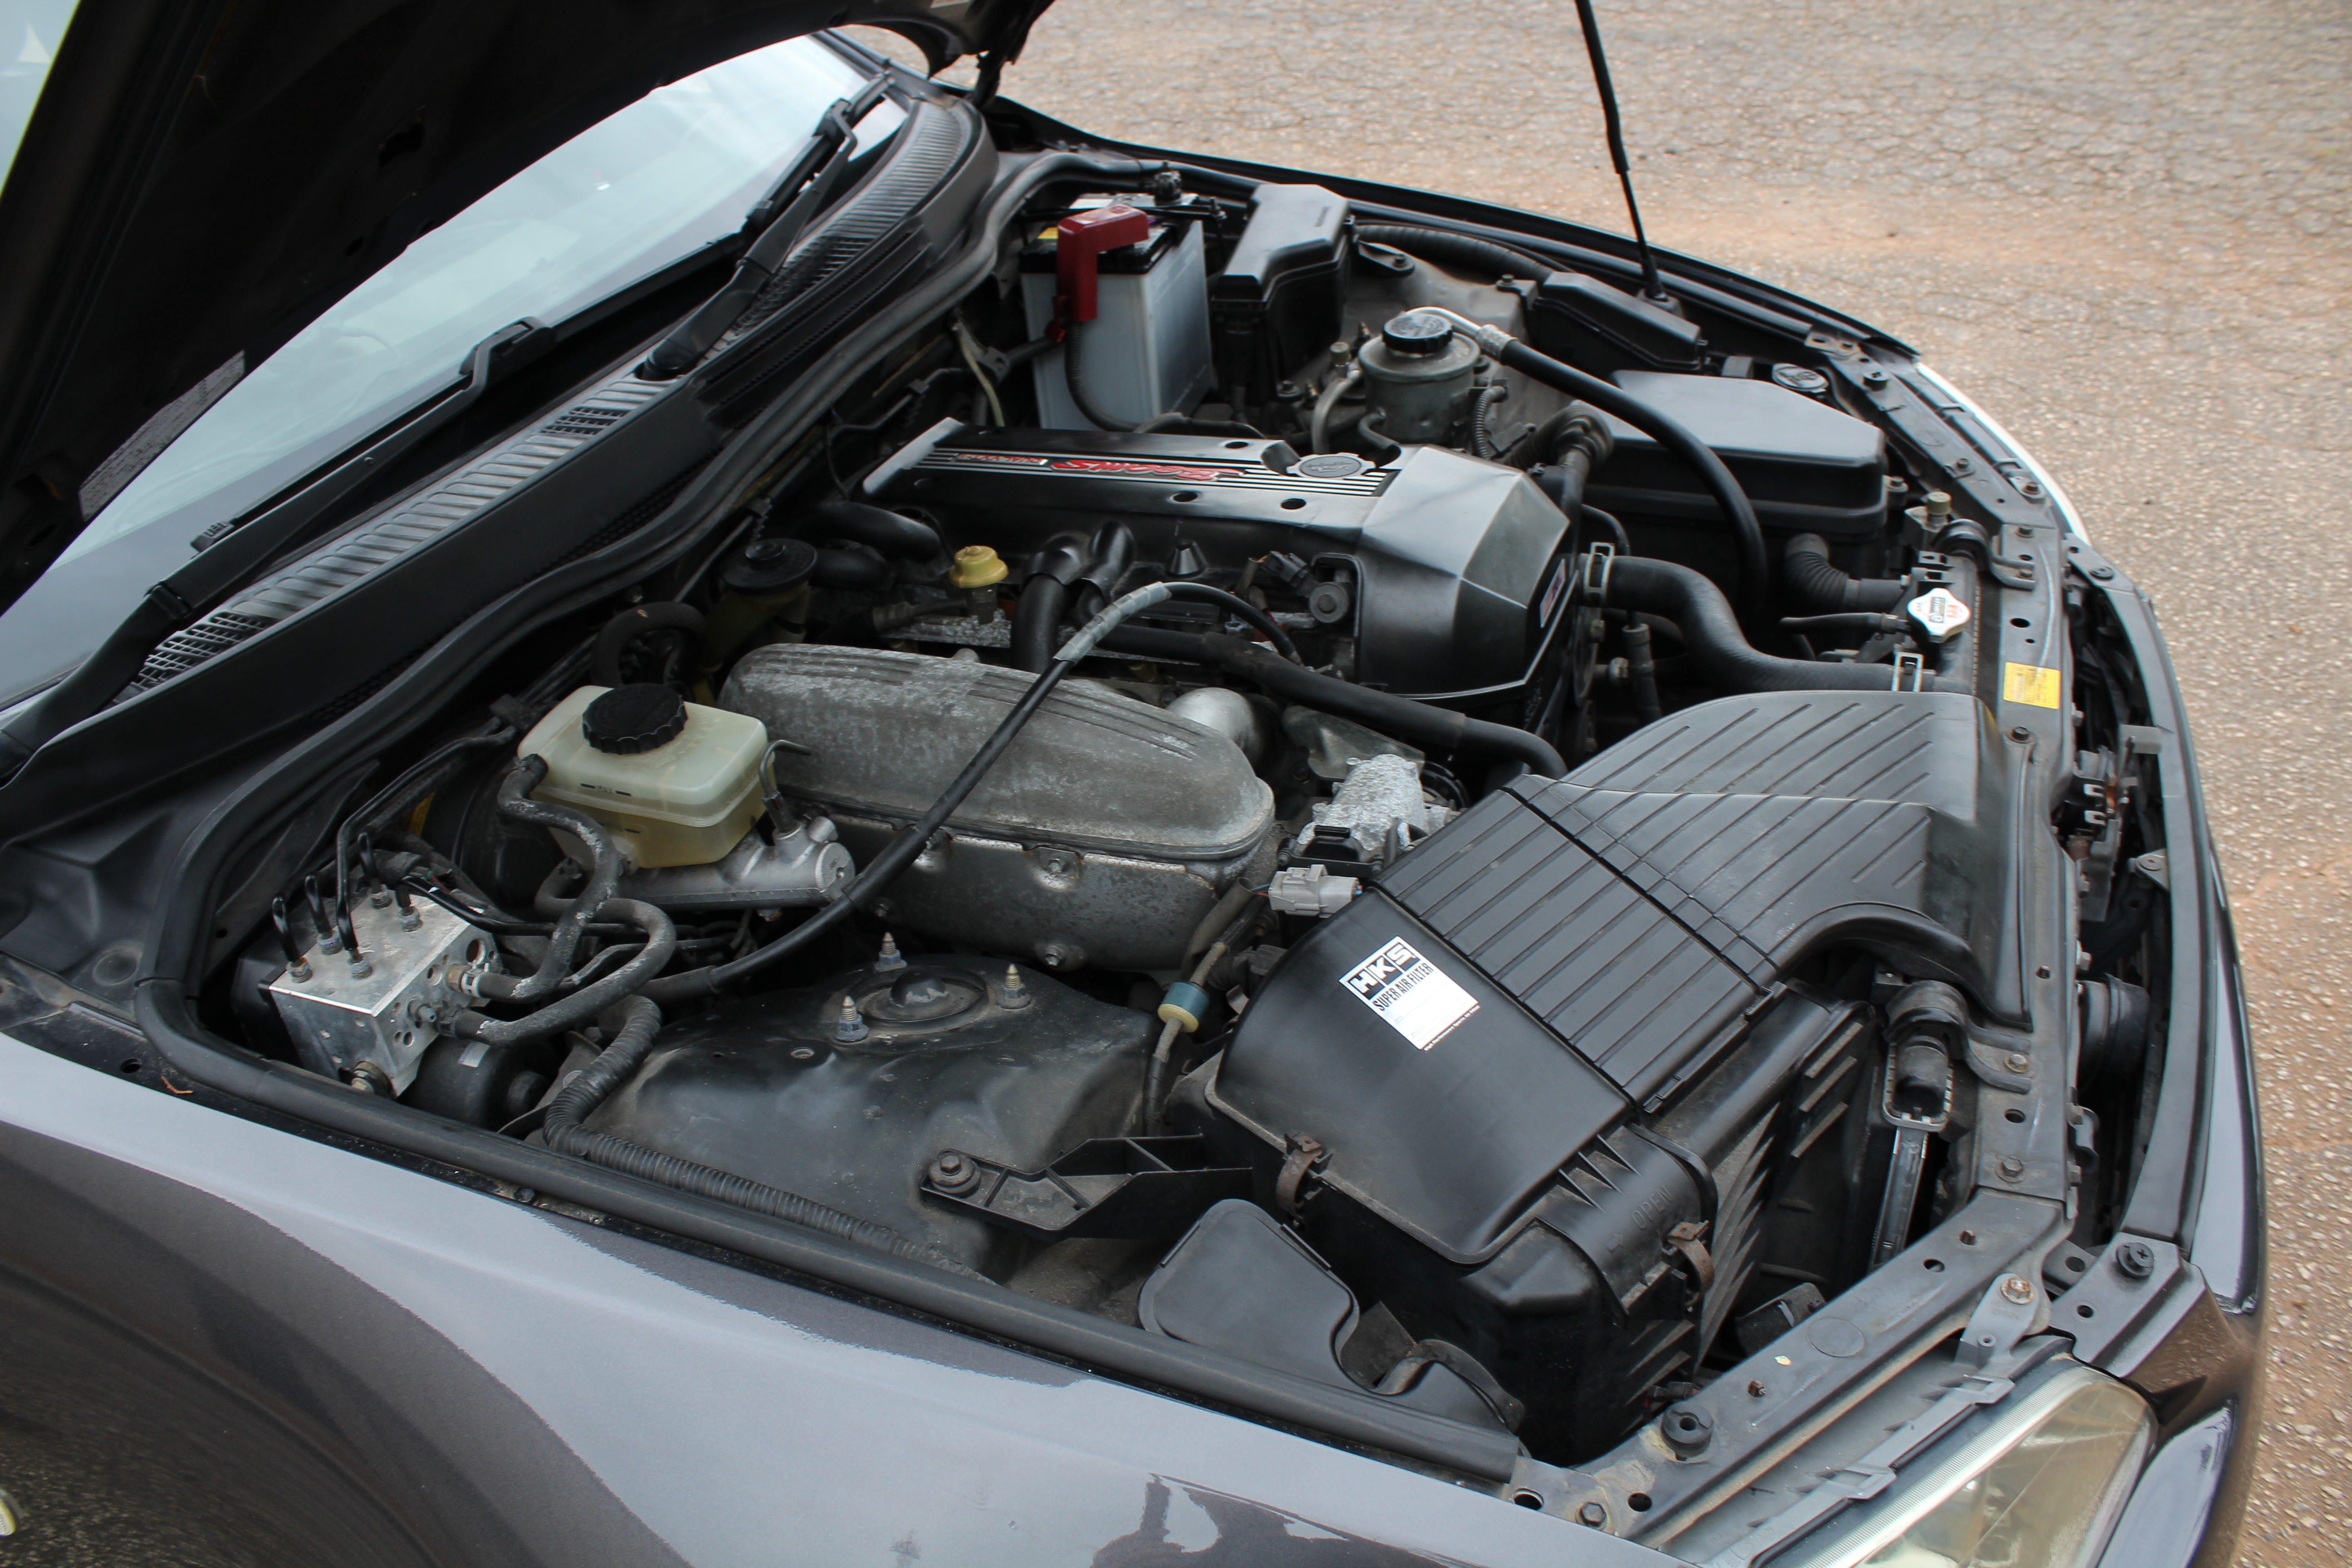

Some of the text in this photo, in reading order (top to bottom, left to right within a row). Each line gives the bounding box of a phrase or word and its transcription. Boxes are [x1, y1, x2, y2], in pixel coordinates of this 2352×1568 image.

[1004, 455, 1043, 463] DUAL
[1349, 944, 1414, 995] HKS
[1372, 962, 1434, 1011] SUPER AIR FILTER
[1632, 1185, 1672, 1229] OPEN
